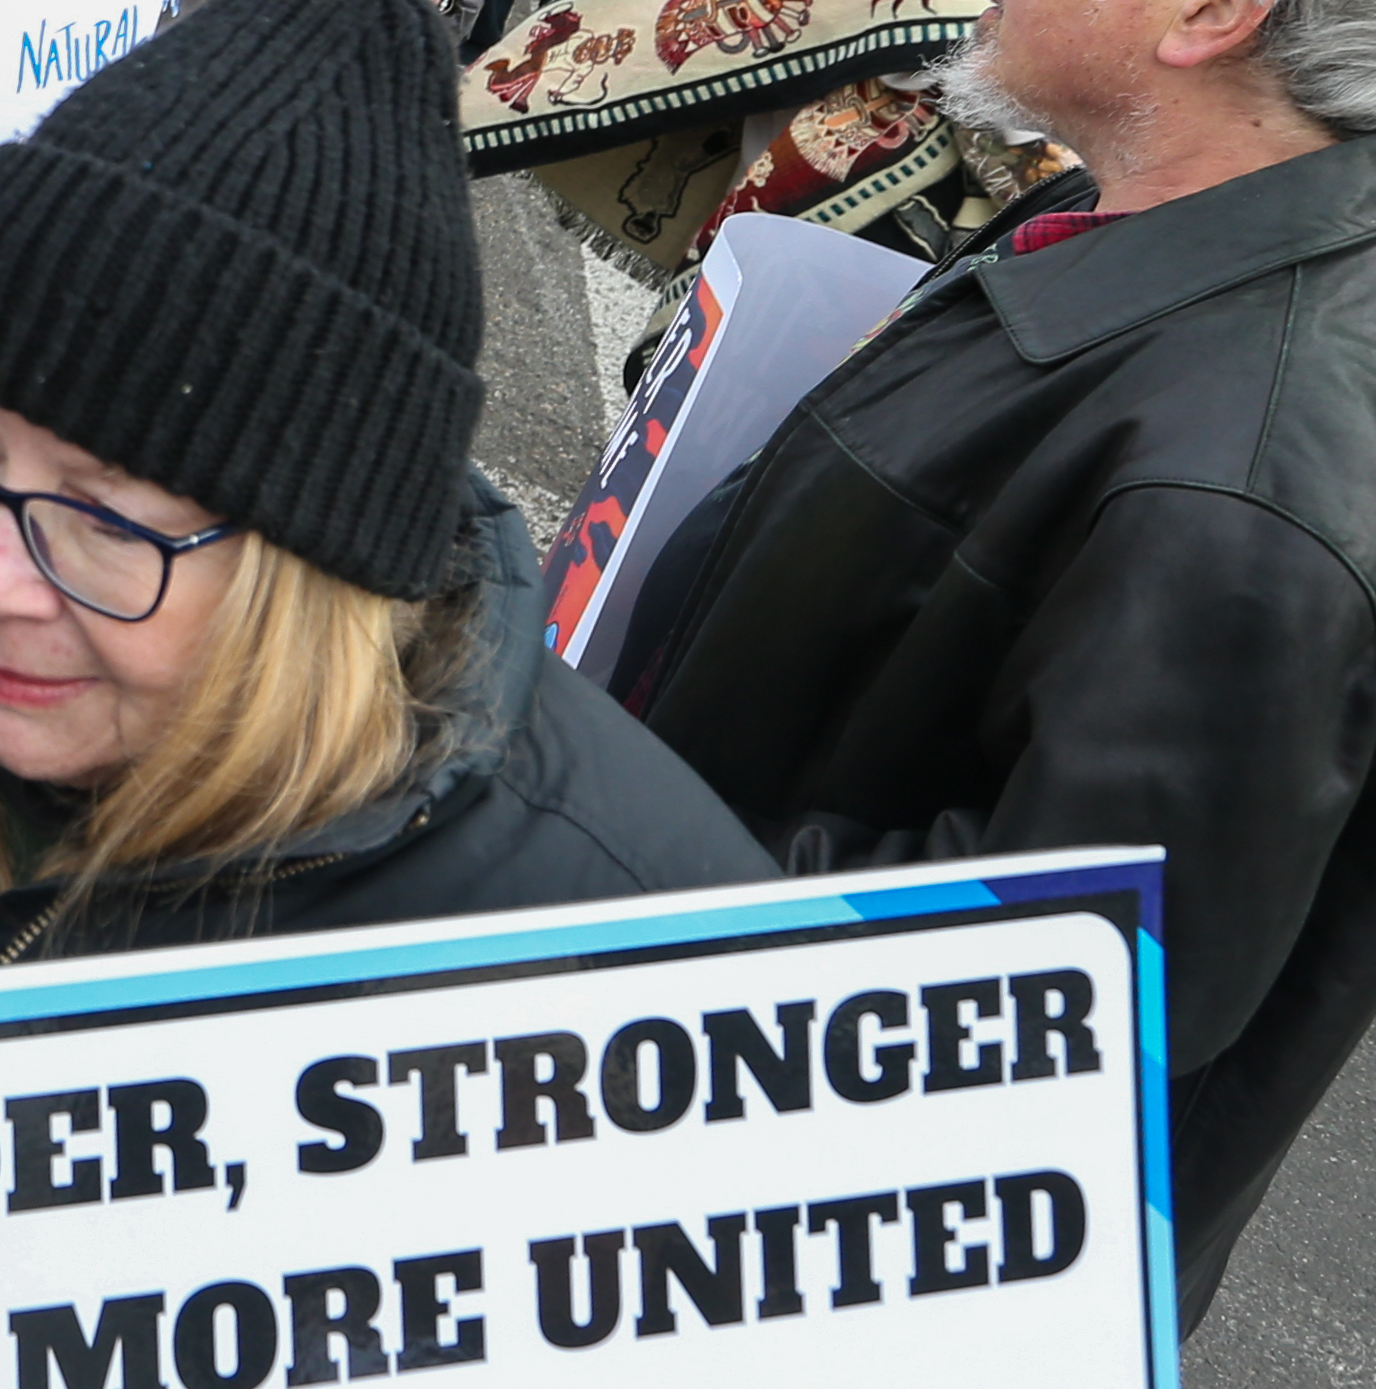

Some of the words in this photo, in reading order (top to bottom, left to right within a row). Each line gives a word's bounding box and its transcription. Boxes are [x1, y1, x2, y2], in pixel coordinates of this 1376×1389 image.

[294, 966, 1105, 1176] STRONGER
[7, 1246, 489, 1389] MORE
[528, 1166, 1089, 1350] UNITED
